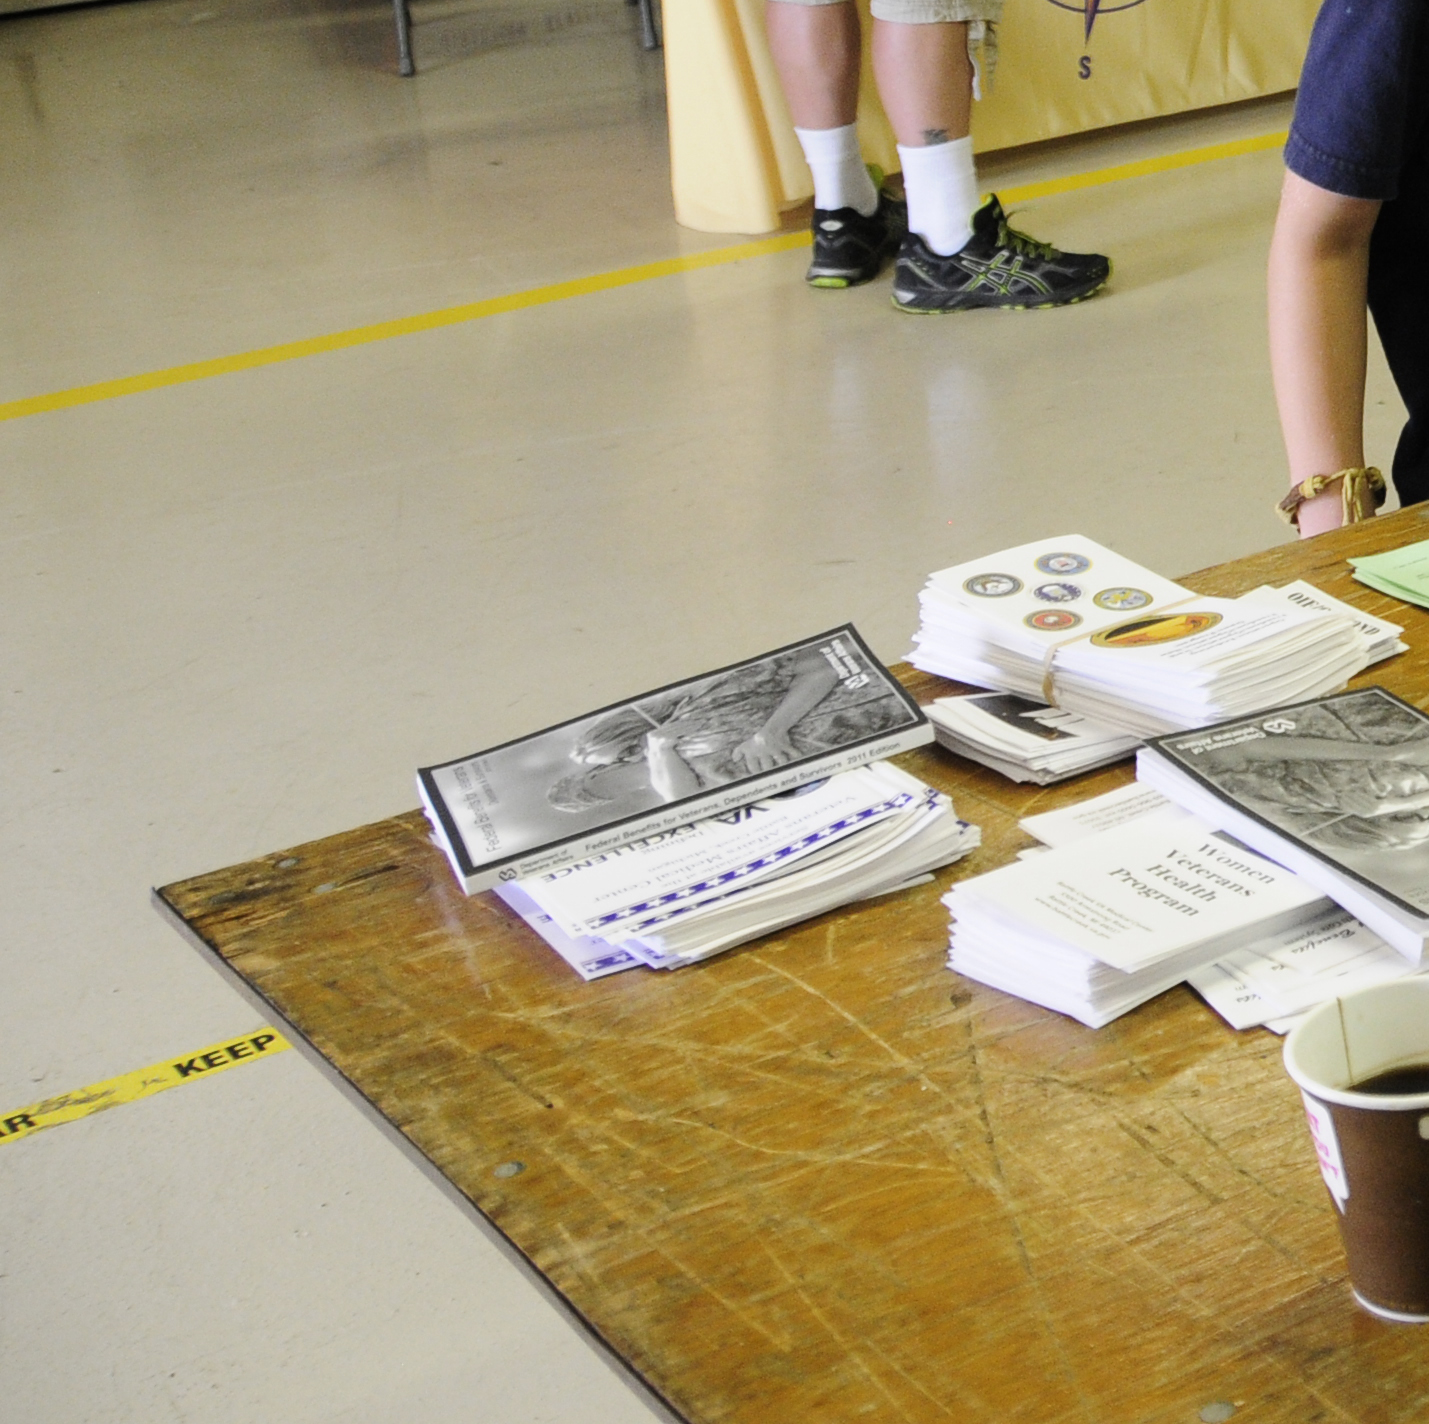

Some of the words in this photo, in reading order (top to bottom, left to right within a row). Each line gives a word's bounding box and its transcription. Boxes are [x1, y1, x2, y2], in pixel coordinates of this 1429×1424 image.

[1078, 56, 1091, 80] S
[585, 834, 620, 852] Federal
[623, 822, 661, 840] Benefits
[662, 816, 677, 826] for
[724, 782, 778, 807] Dependents
[780, 775, 798, 787] and
[799, 761, 843, 783] Survivors
[847, 752, 867, 765] 2011
[869, 742, 901, 758] Edition
[713, 804, 770, 825] VA
[541, 822, 697, 883] EXCELLENCE
[1166, 849, 1256, 898] Veterans
[1198, 843, 1277, 885] Women
[593, 879, 652, 903] Center
[1108, 868, 1200, 918] Program
[1146, 864, 1218, 903] Health
[173, 1033, 276, 1078] KEEP
